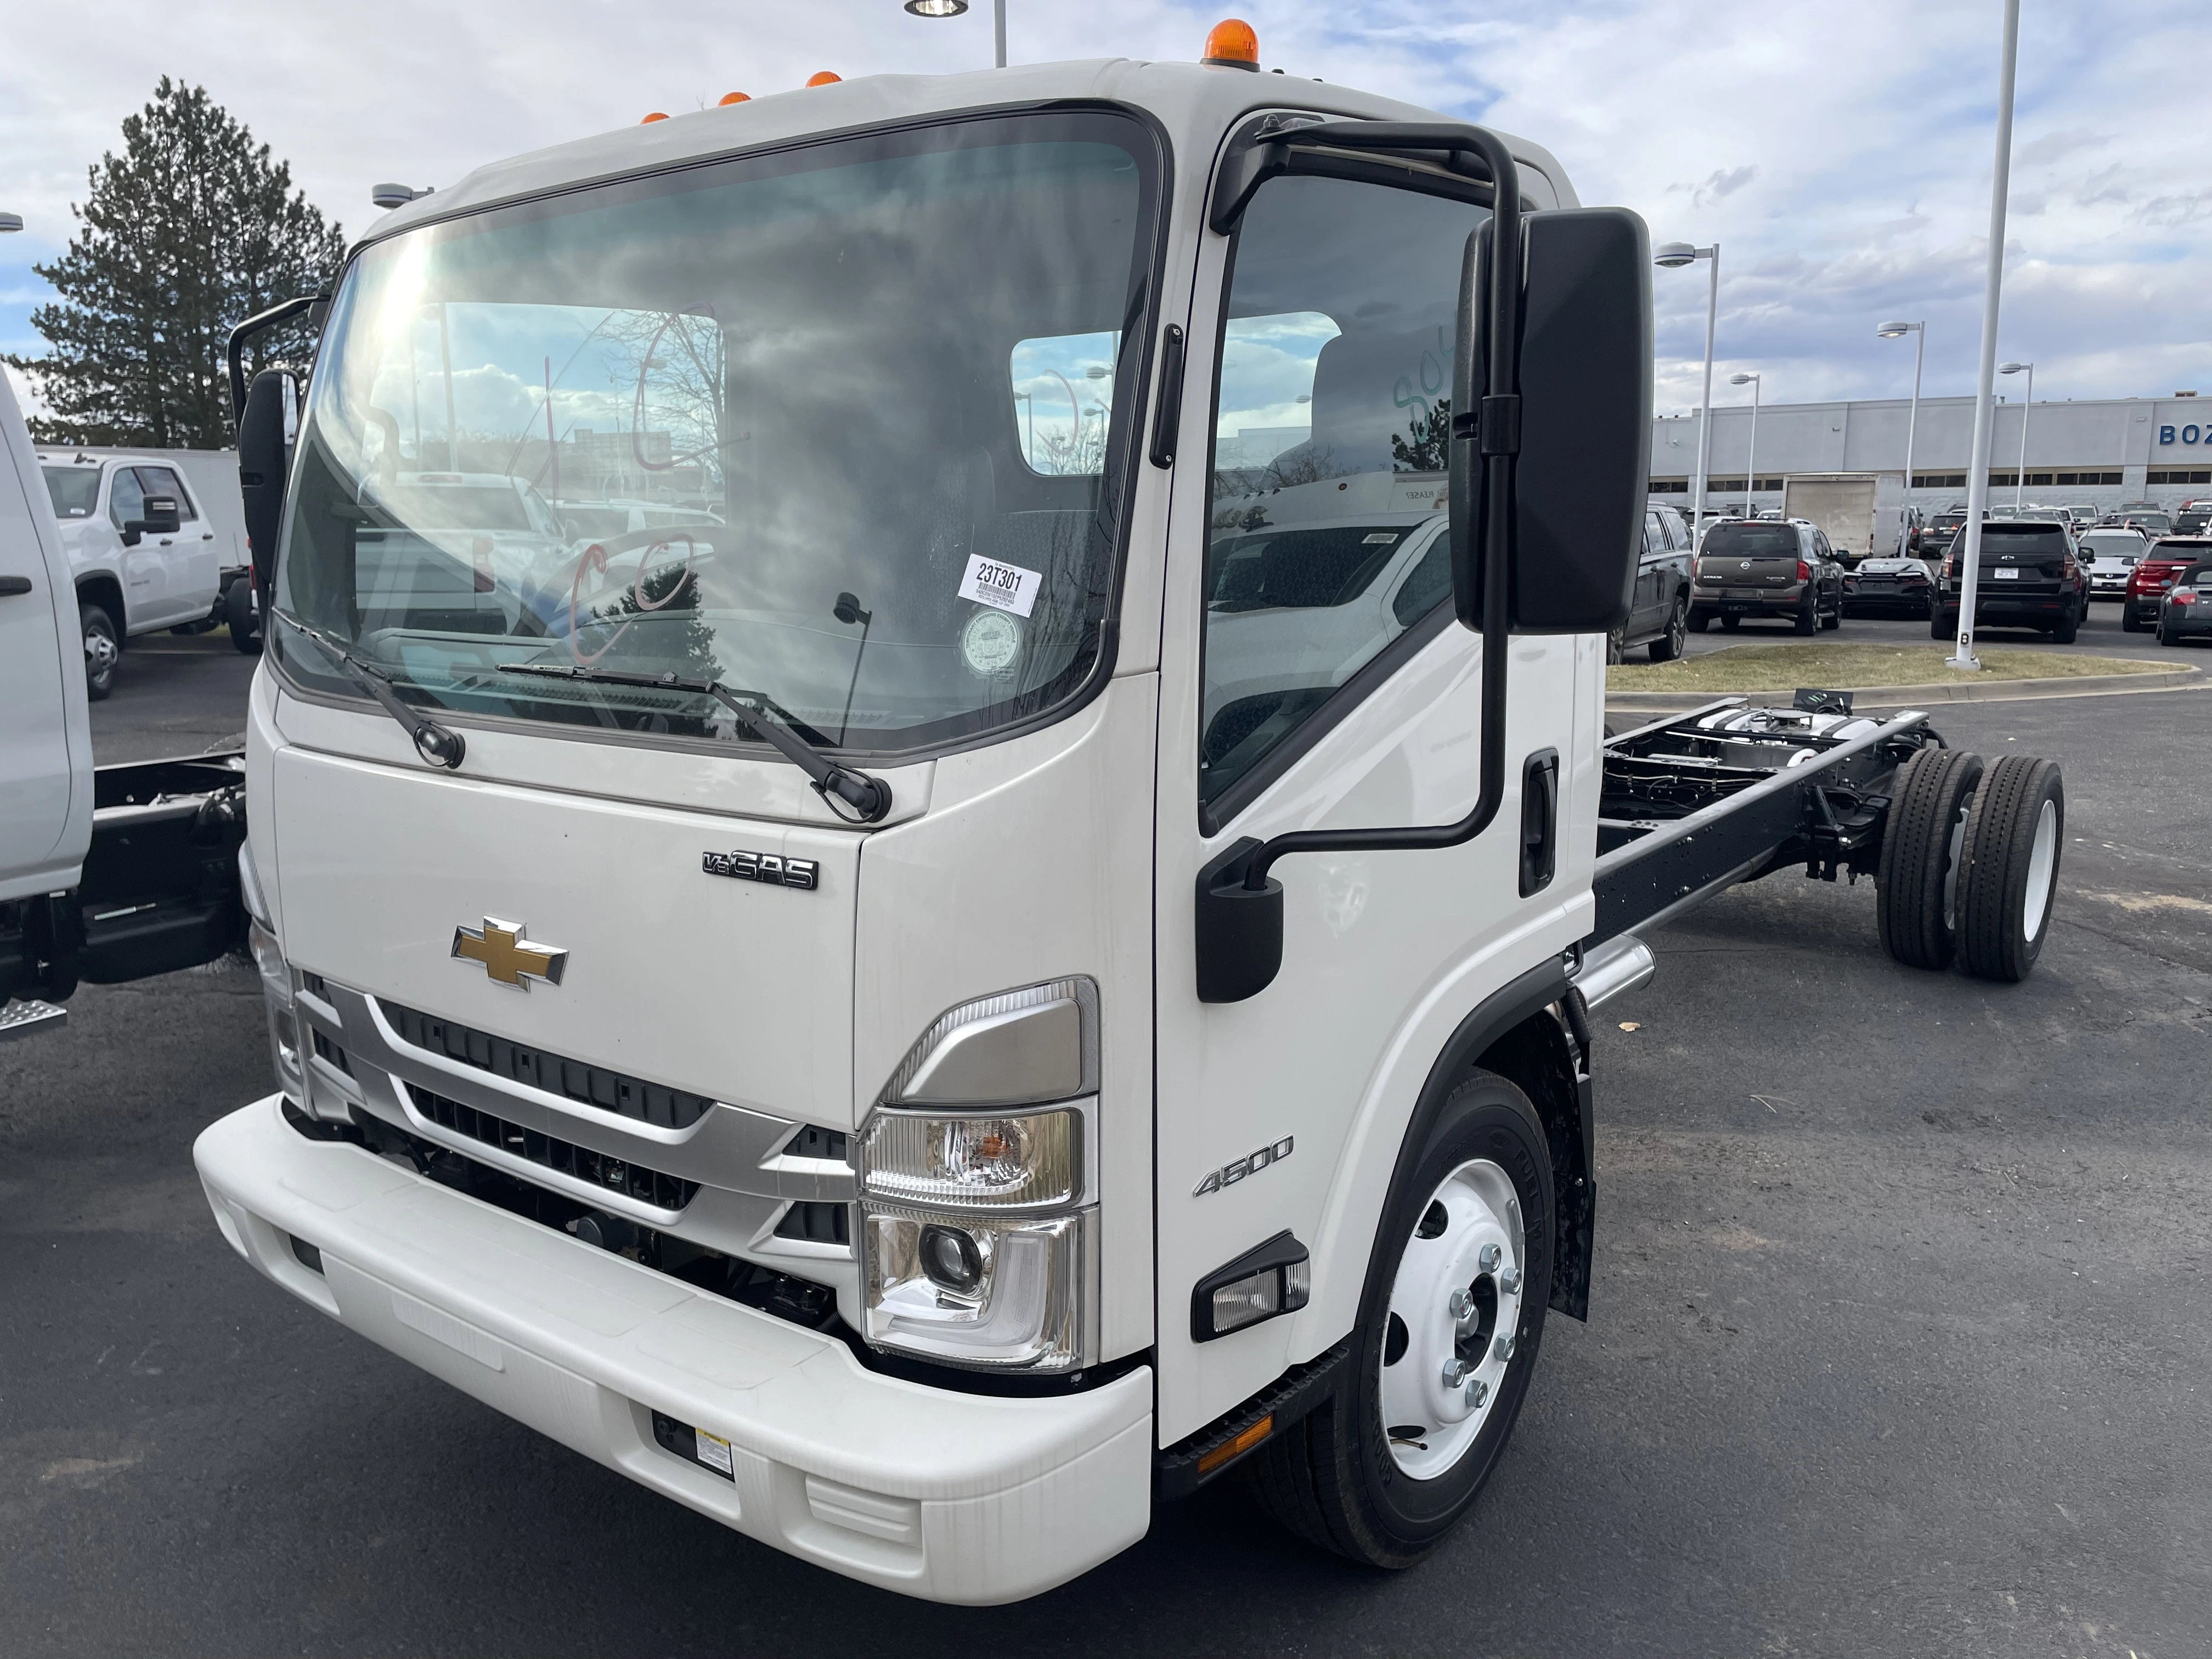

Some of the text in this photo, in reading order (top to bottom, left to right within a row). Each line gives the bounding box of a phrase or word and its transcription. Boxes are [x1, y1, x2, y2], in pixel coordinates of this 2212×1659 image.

[976, 563, 1022, 592] 23T301
[966, 622, 976, 649] TEMPORARY
[975, 613, 996, 623] EMISSIONS
[997, 613, 1011, 624] EXEMPT
[990, 619, 1011, 641] COLORADO
[1193, 1133, 1294, 1198] 4500
[1514, 1149, 1539, 1211] FUEL
[1526, 1218, 1543, 1289] MAX
